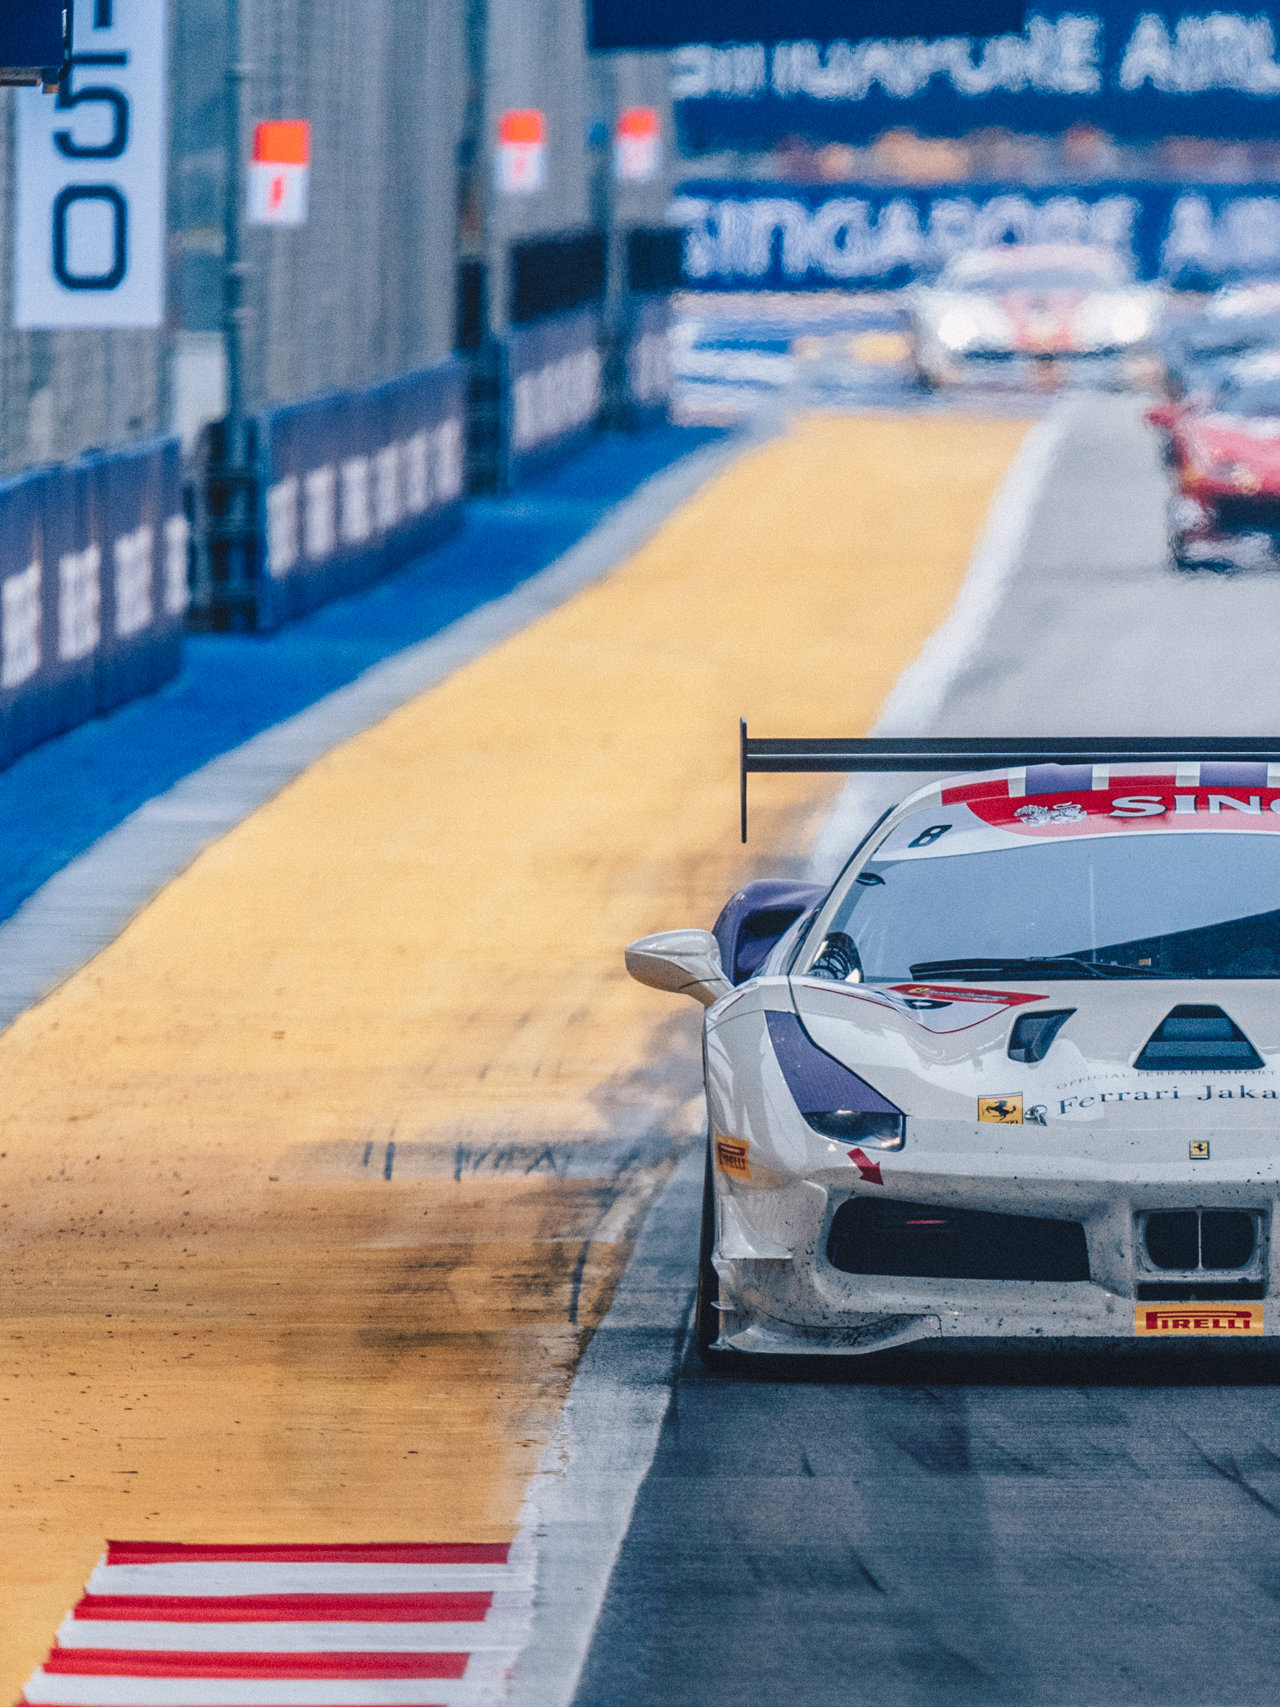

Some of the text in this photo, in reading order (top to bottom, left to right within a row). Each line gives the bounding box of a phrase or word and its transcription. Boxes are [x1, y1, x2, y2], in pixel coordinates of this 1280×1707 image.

[53, 0, 128, 290] 50
[907, 824, 953, 848] 8
[1057, 1086, 1180, 1115] Ferrari
[718, 1142, 746, 1170] PIRELLI
[1146, 1310, 1252, 1330] PIRELLI
